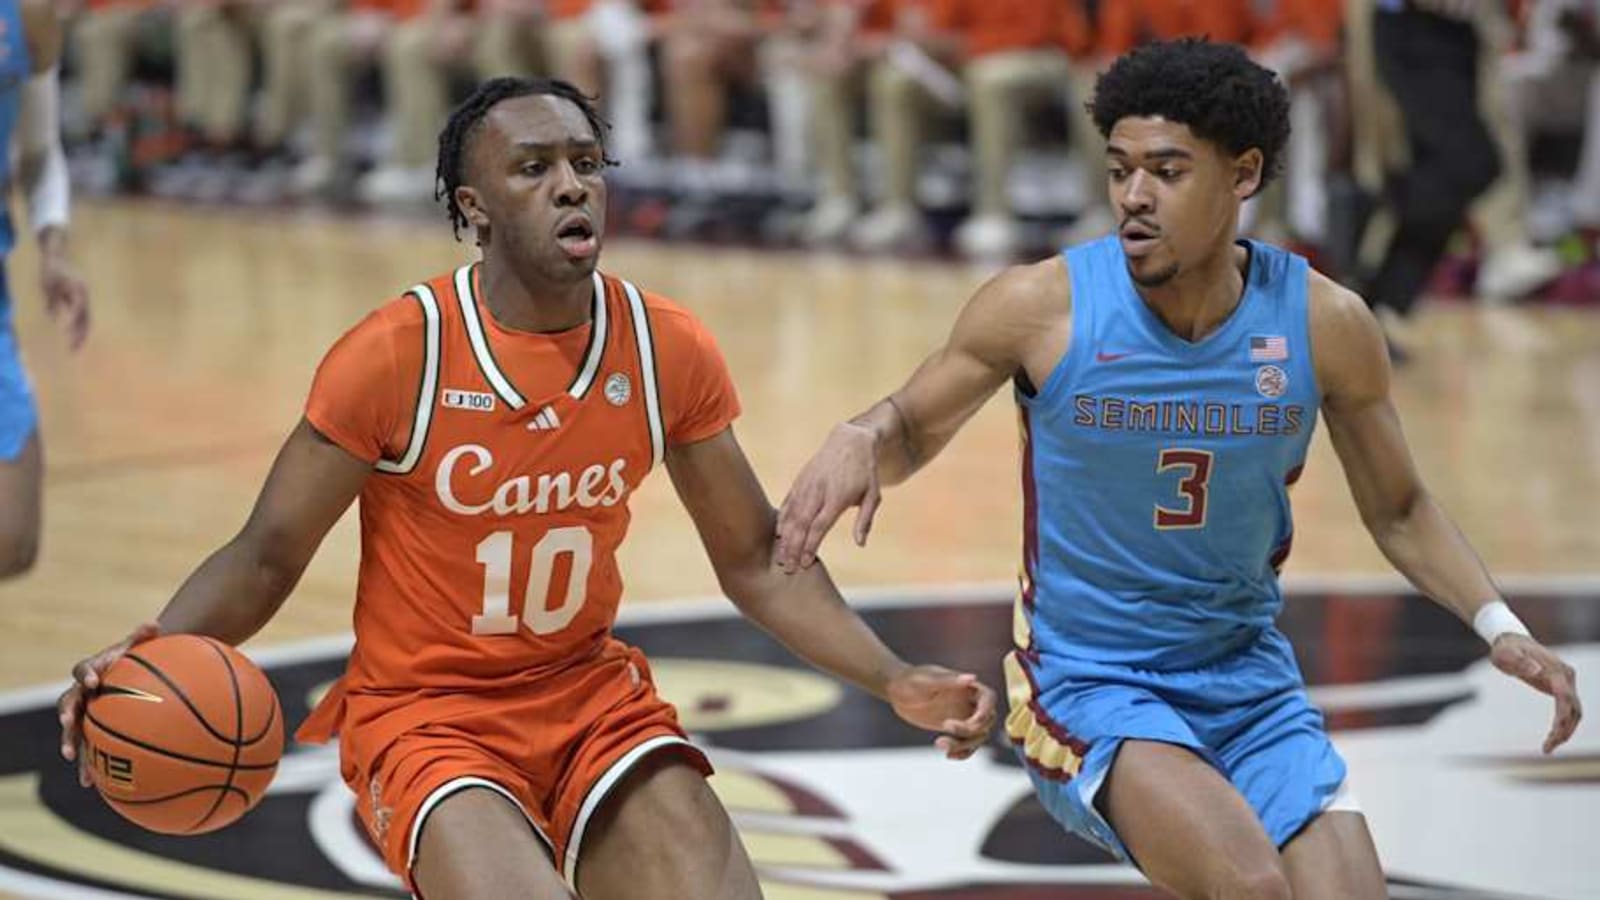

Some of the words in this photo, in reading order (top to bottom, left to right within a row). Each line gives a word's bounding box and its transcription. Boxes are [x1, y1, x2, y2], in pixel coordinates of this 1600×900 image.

[468, 394, 493, 409] 100
[1074, 395, 1304, 436] SEMINOLES
[435, 444, 627, 516] Canes
[1153, 447, 1214, 530] 3
[471, 525, 593, 636] 10
